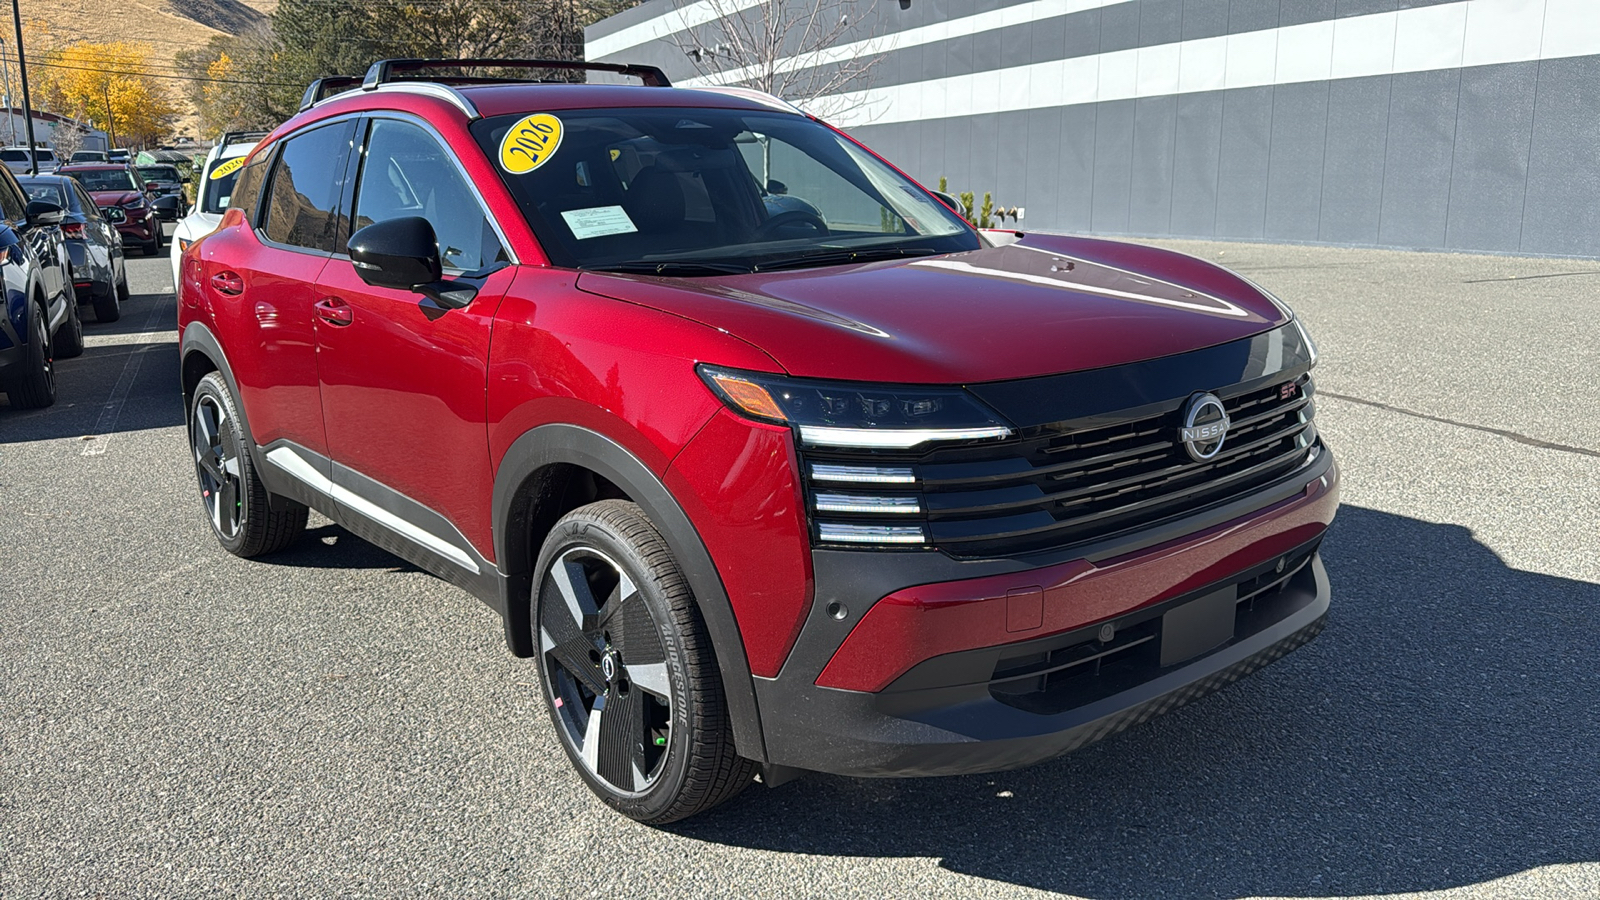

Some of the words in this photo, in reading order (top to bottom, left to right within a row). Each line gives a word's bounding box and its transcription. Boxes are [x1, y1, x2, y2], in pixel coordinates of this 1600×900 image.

[510, 119, 554, 163] 2026
[218, 159, 243, 175] 2026
[1281, 382, 1296, 400] SR
[1184, 420, 1230, 440] NISSAN
[661, 623, 688, 728] BRIDGESTONE
